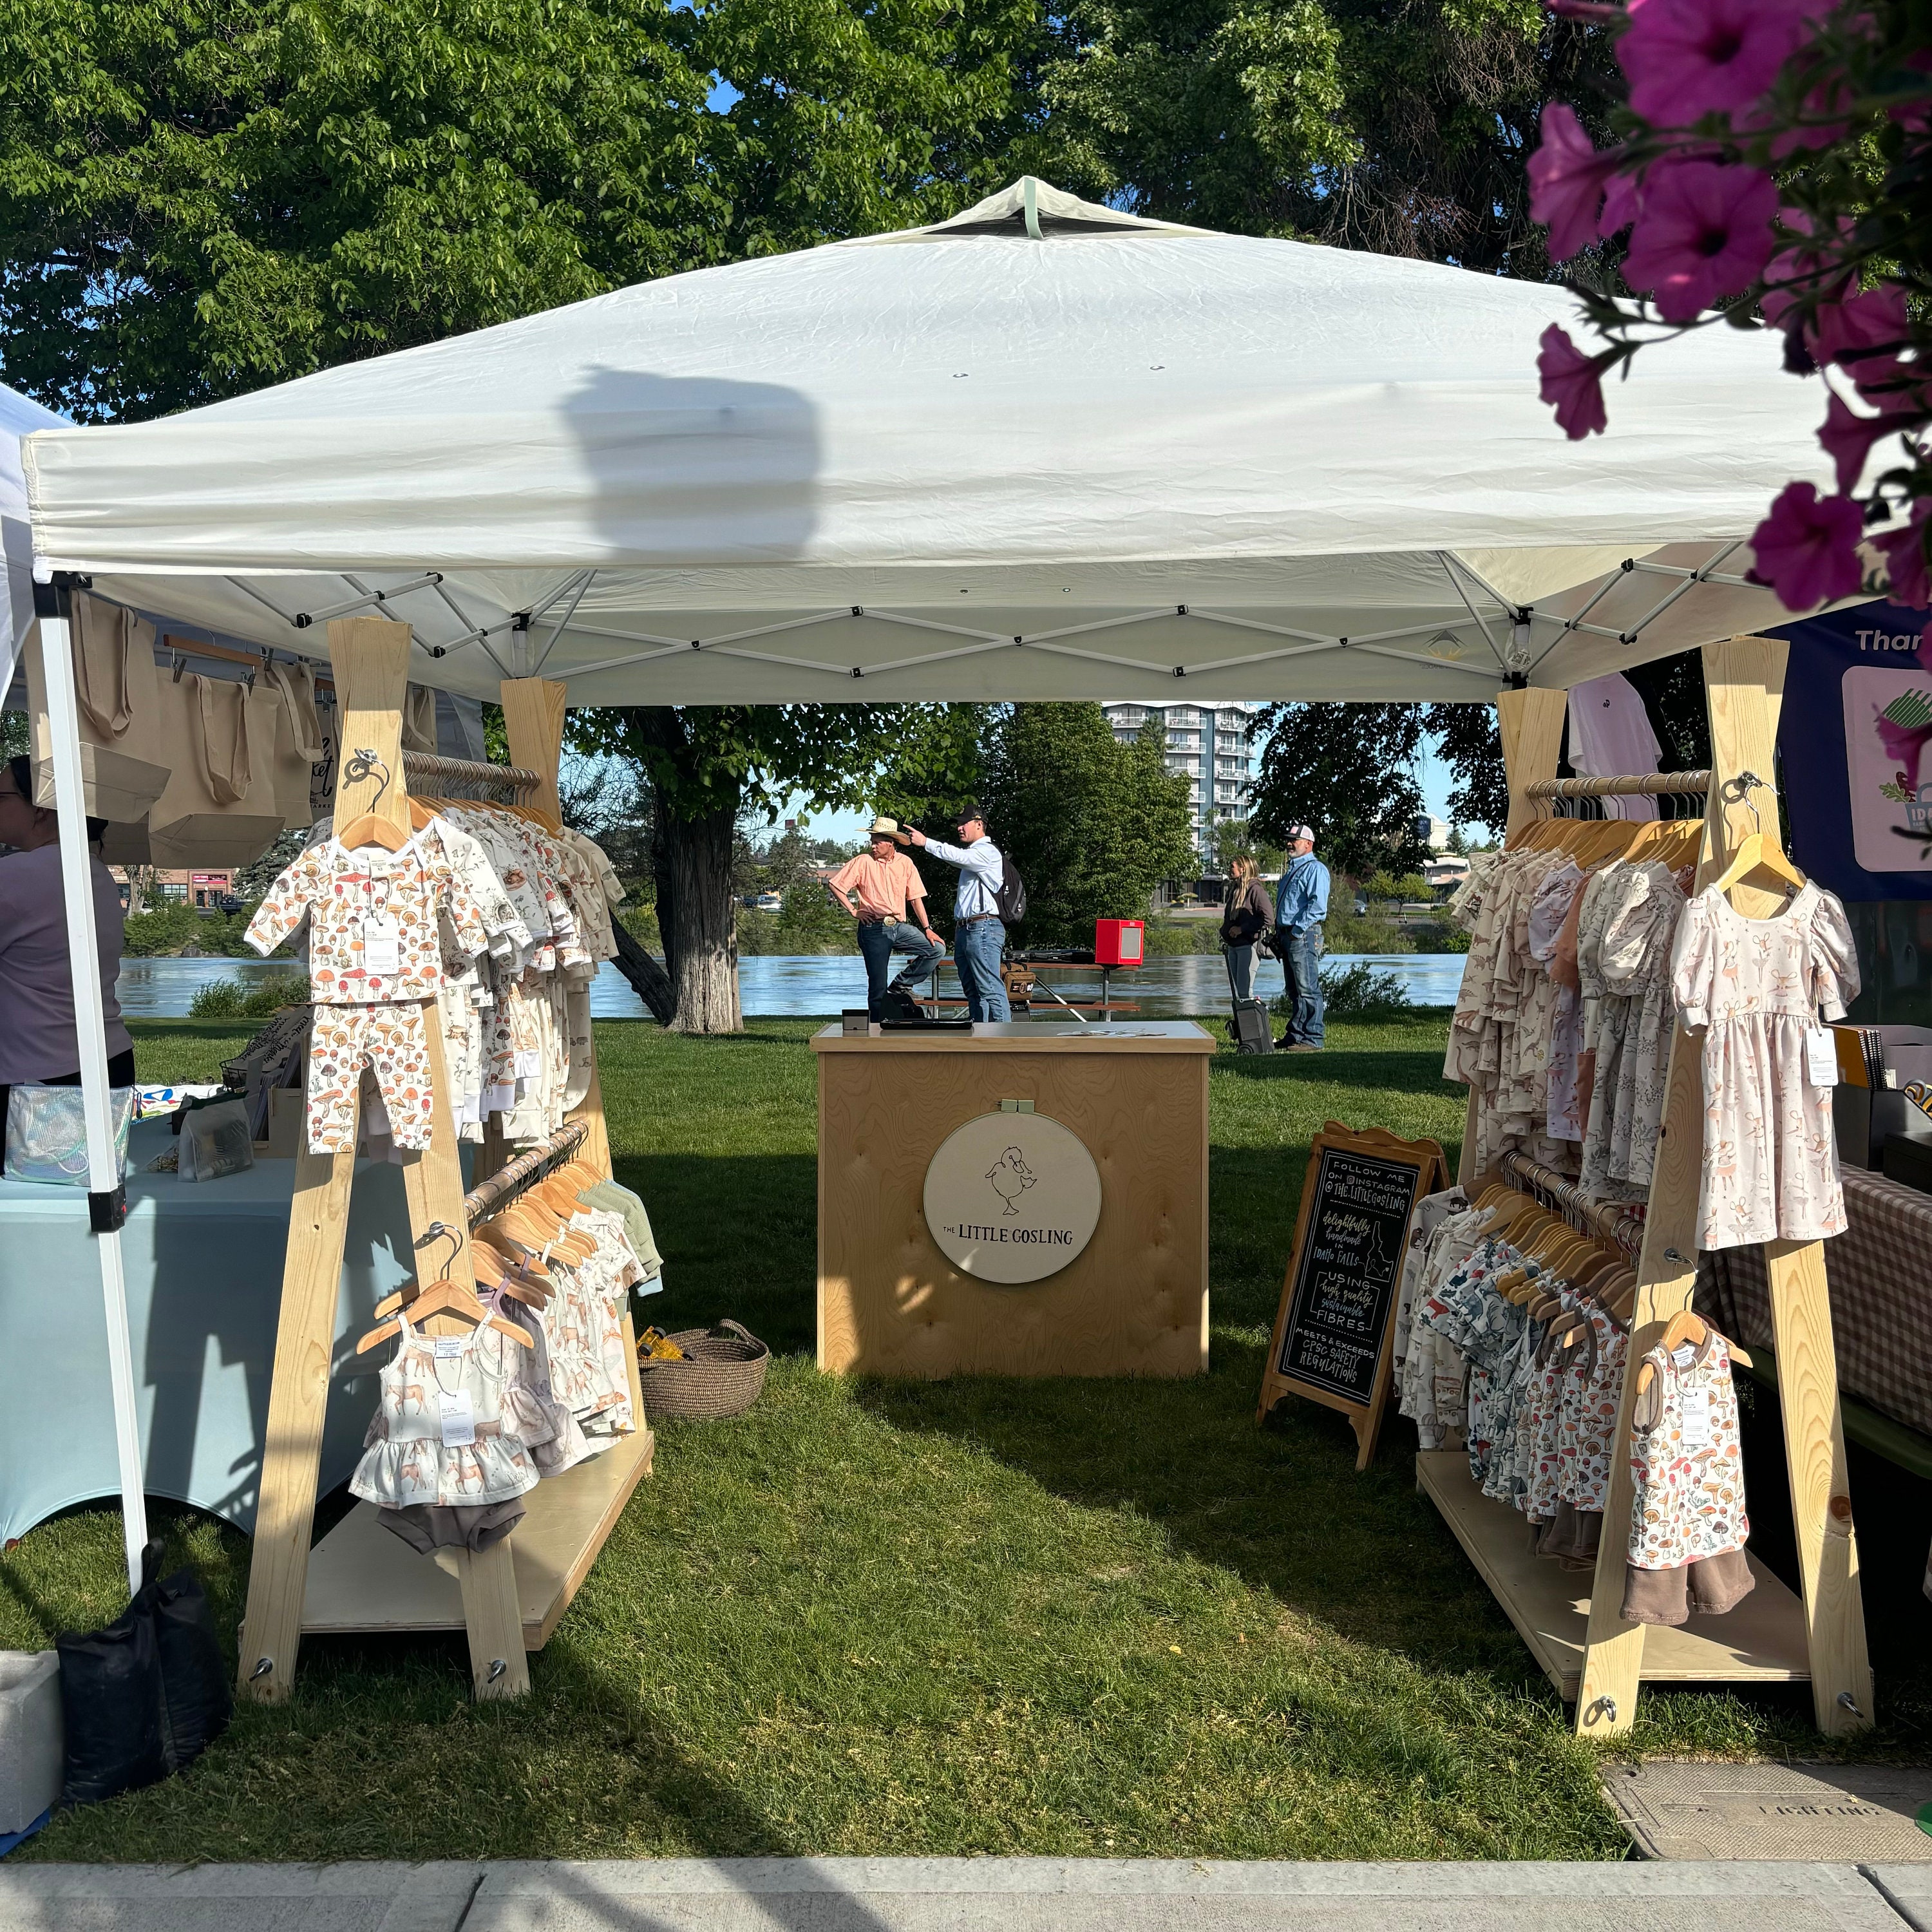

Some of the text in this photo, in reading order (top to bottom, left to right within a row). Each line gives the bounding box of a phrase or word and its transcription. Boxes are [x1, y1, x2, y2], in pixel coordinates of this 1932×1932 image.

[1334, 1161, 1405, 1182] FOLLOW ME
[1356, 1178, 1410, 1195] INSTAGRAM
[1323, 1211, 1370, 1236] delightfully
[958, 1224, 1008, 1242] LITTLE
[1012, 1229, 1073, 1245] GOSLING
[1325, 1226, 1361, 1245] handmade
[1336, 1251, 1359, 1267] FALLS
[1328, 1271, 1370, 1290] USING
[1320, 1280, 1373, 1309] high quality
[1321, 1296, 1365, 1317] sustainable
[1317, 1310, 1365, 1331] FIBRES
[1295, 1327, 1327, 1341] MEETS
[1336, 1340, 1375, 1359] EXCEEDS
[1303, 1340, 1360, 1369] CPSC SAFETY
